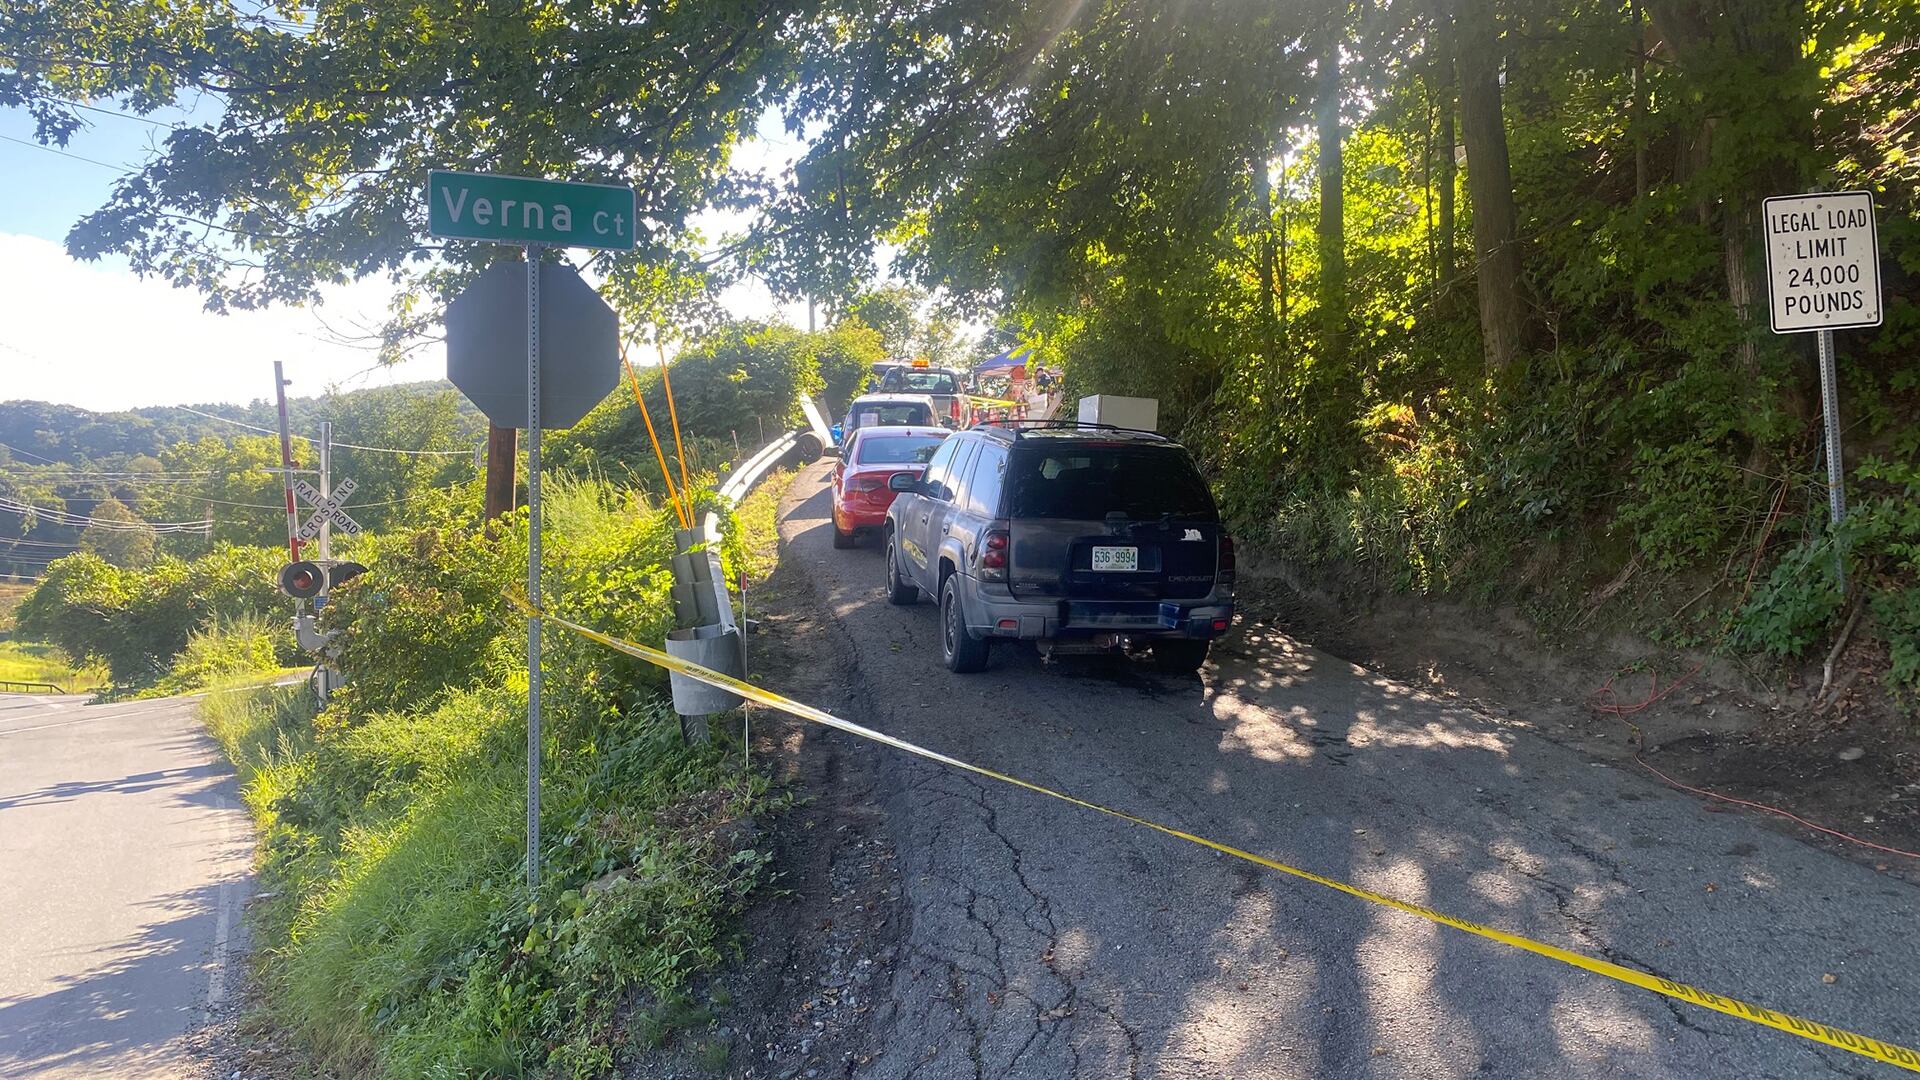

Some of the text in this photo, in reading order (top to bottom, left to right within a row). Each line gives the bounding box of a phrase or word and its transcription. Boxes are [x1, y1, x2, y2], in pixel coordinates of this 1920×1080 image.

[441, 186, 625, 236] Verna Ct
[1772, 208, 1867, 234] LEGAL LOAD
[1796, 237, 1847, 259] LIMIT
[1788, 264, 1859, 289] 24,000
[1785, 290, 1863, 316] POUNDS
[296, 482, 358, 534] RAIL ROAD
[301, 480, 354, 538] CROSSING
[1094, 551, 1136, 563] 536 9994
